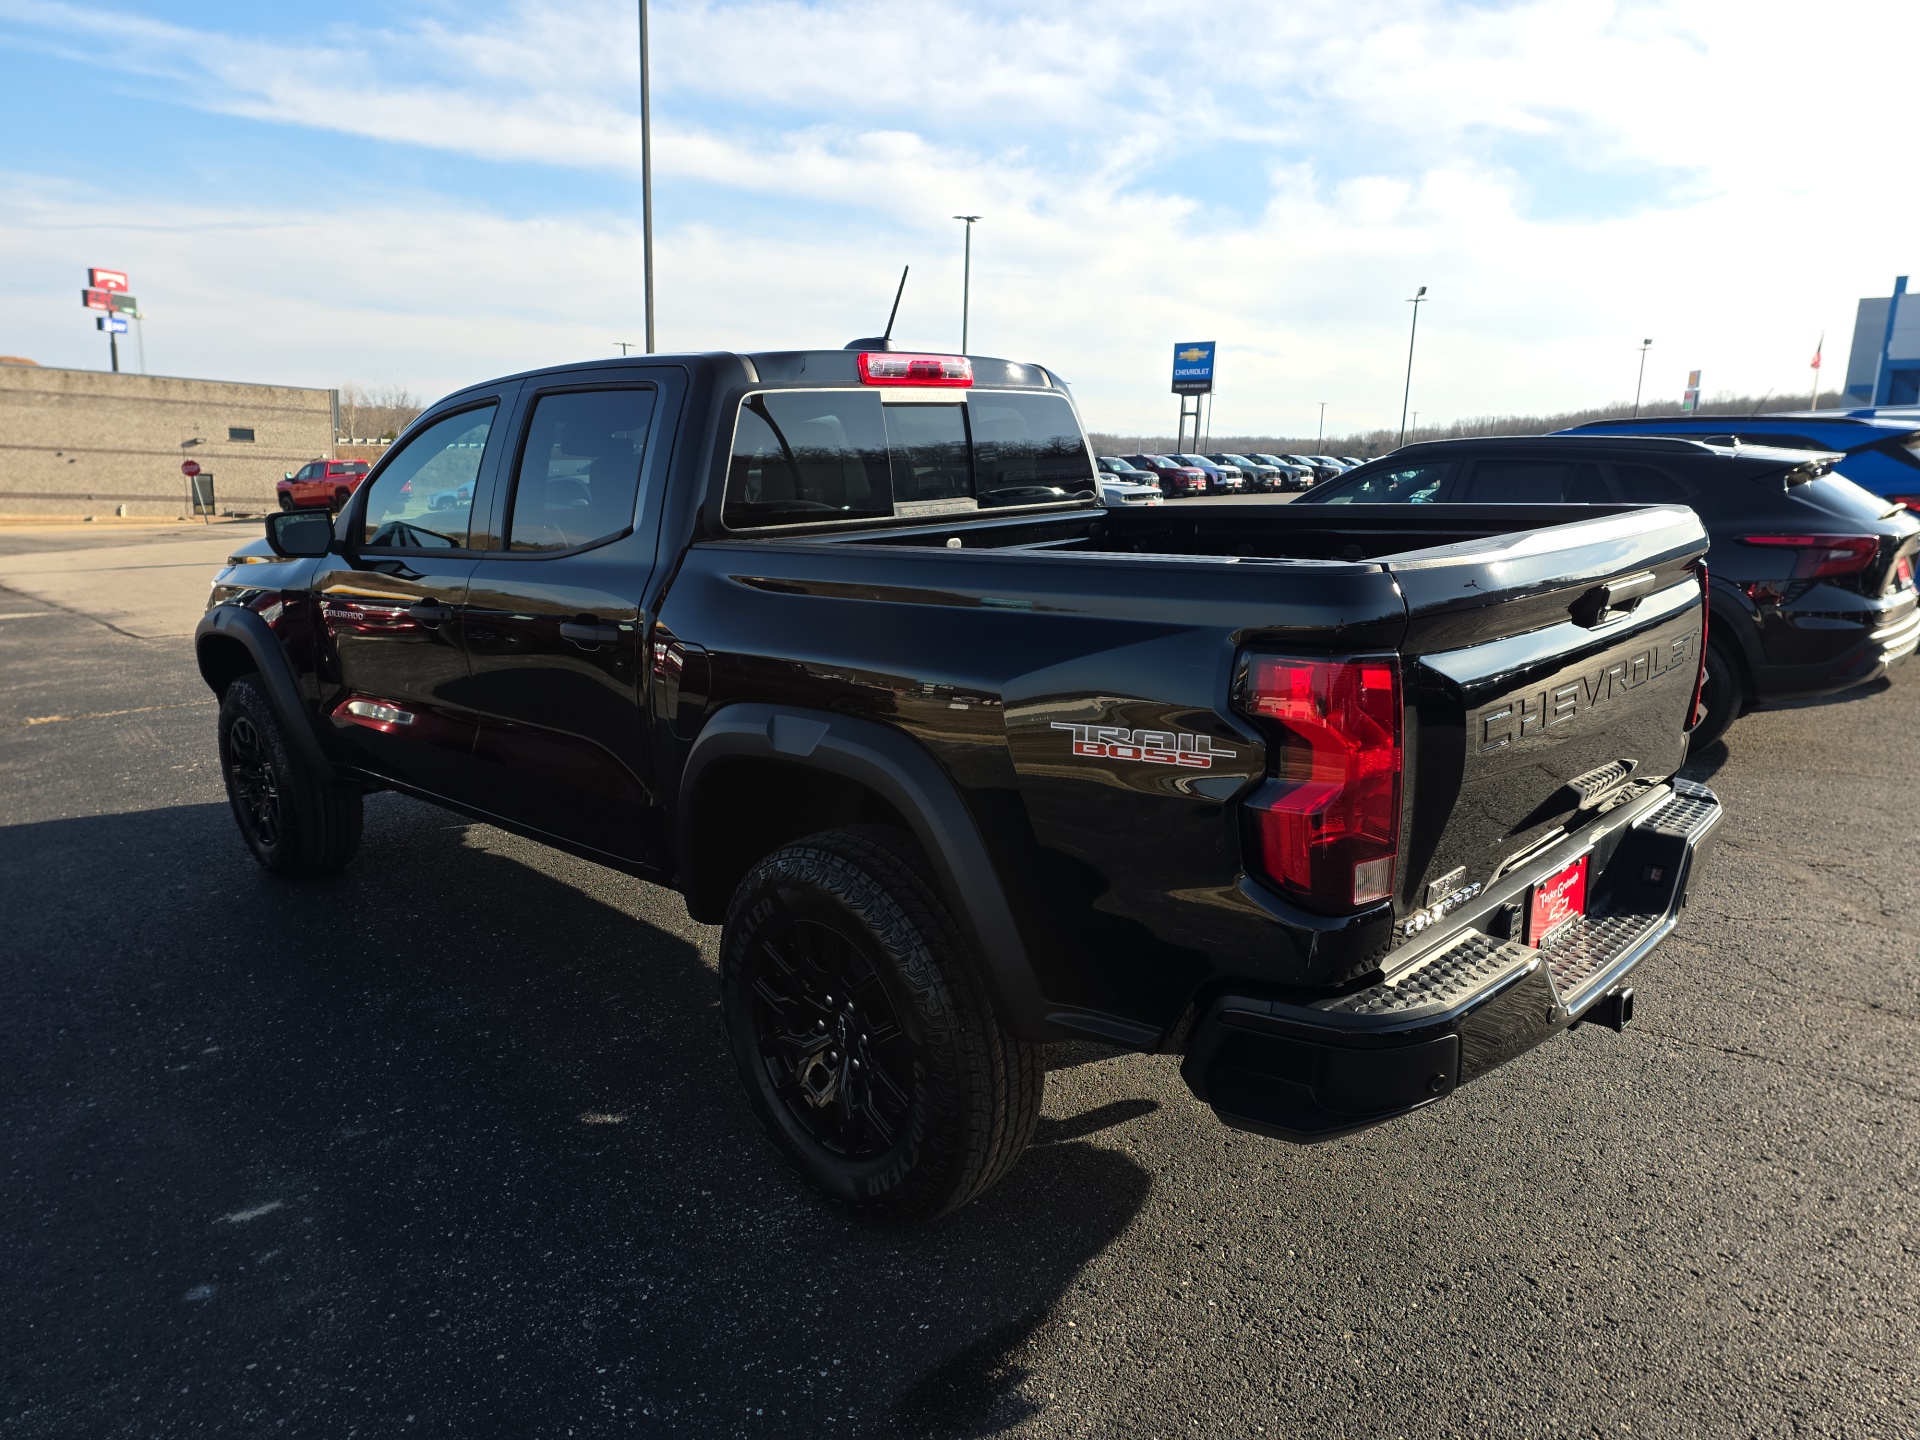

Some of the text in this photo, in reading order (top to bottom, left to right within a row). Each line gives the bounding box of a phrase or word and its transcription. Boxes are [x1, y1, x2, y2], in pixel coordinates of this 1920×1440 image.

[1175, 368, 1210, 376] CHEVROLET
[182, 464, 199, 474] STOP
[323, 608, 364, 621] COLORADO
[1475, 627, 1701, 754] CHEVROLET
[1050, 721, 1237, 758] TRAIL
[1073, 741, 1212, 769] BOSS
[726, 896, 777, 1018] RANGLER
